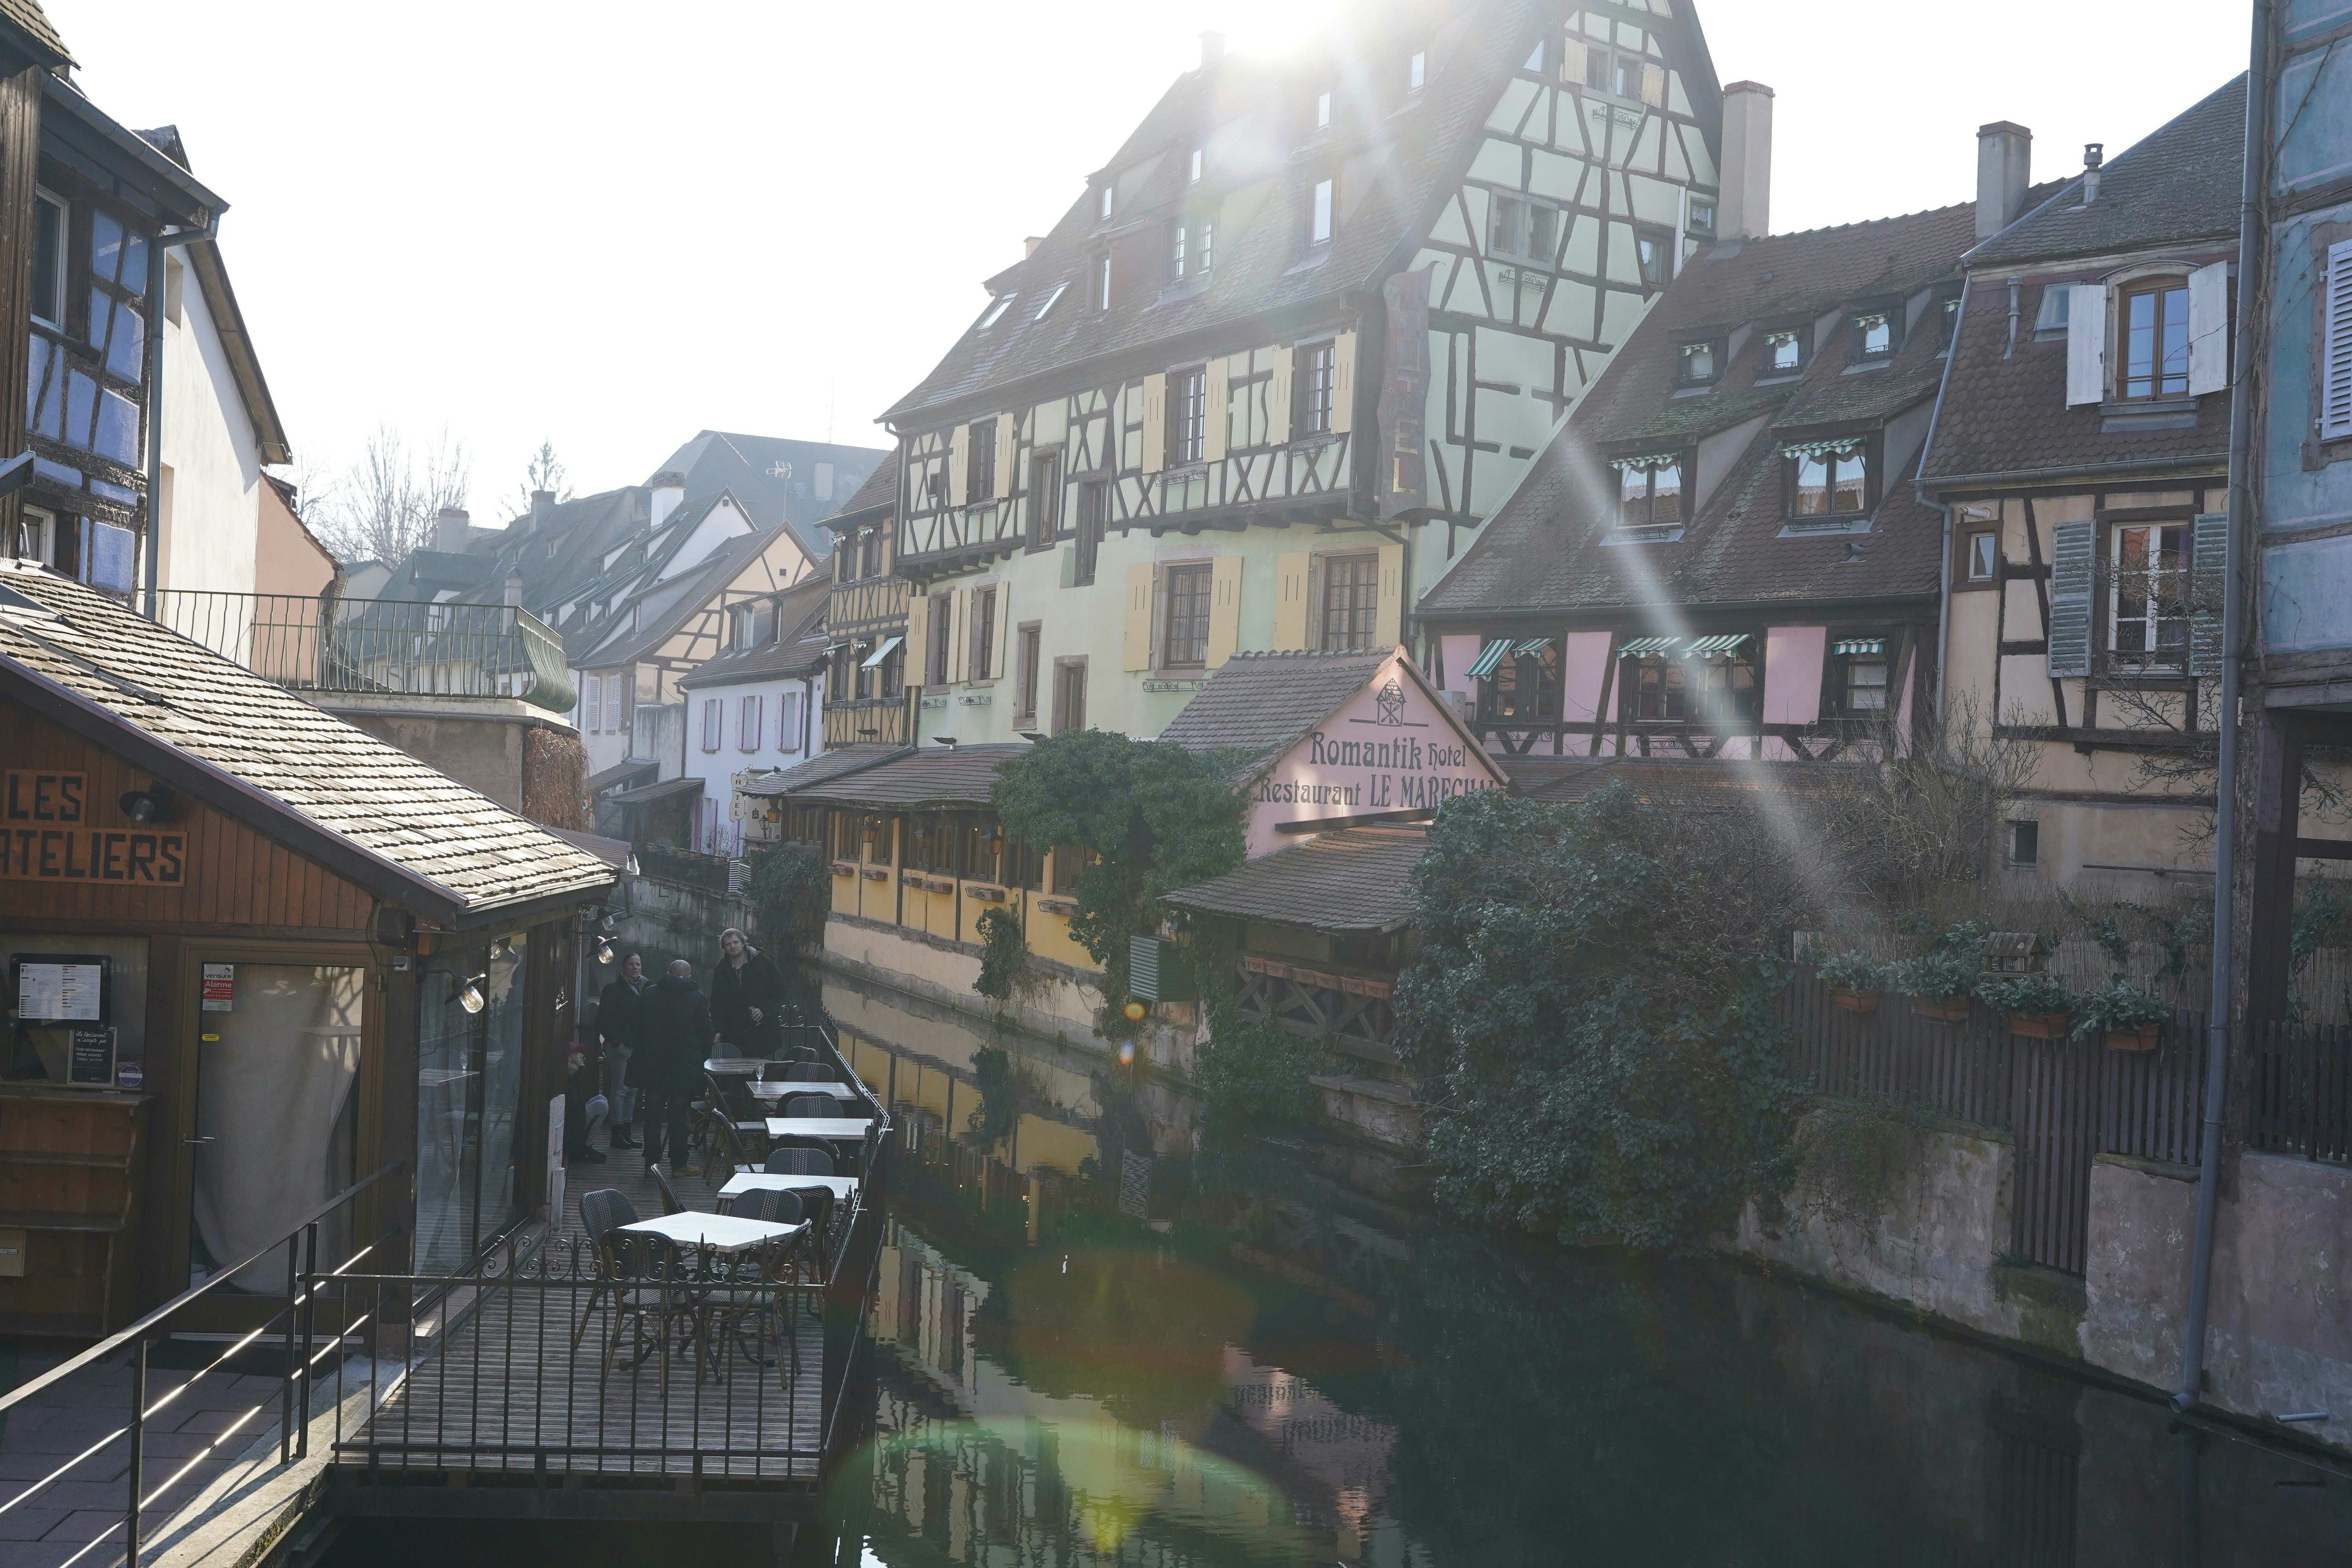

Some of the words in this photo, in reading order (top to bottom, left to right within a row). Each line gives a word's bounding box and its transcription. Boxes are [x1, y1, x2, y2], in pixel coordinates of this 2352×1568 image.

[1310, 731, 1422, 770] Romantik
[8, 775, 82, 821] LES
[1259, 777, 1361, 806] Restaurant
[1370, 774, 1391, 807] LE
[1399, 775, 1494, 808] MARECH
